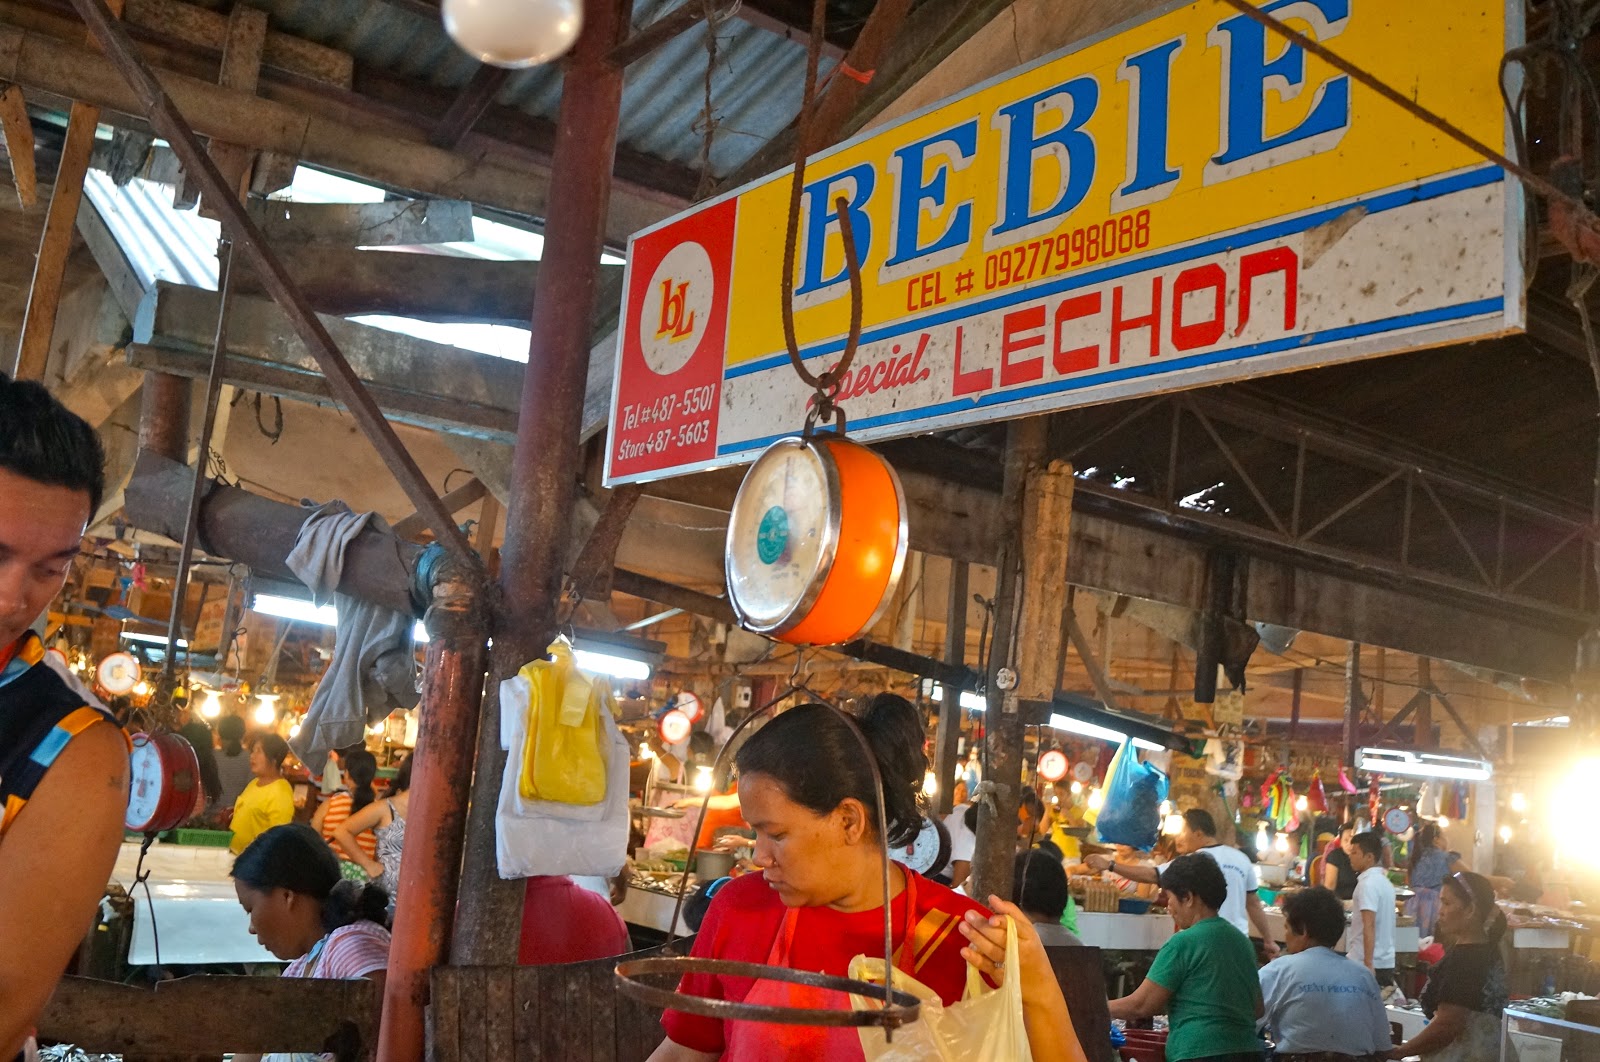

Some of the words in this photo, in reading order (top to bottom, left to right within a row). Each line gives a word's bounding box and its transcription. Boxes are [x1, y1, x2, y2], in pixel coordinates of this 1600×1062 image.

[793, 0, 1350, 298] BEBIE
[907, 273, 946, 312] CEL
[985, 210, 1151, 289] 09277998088
[617, 438, 645, 461] Store
